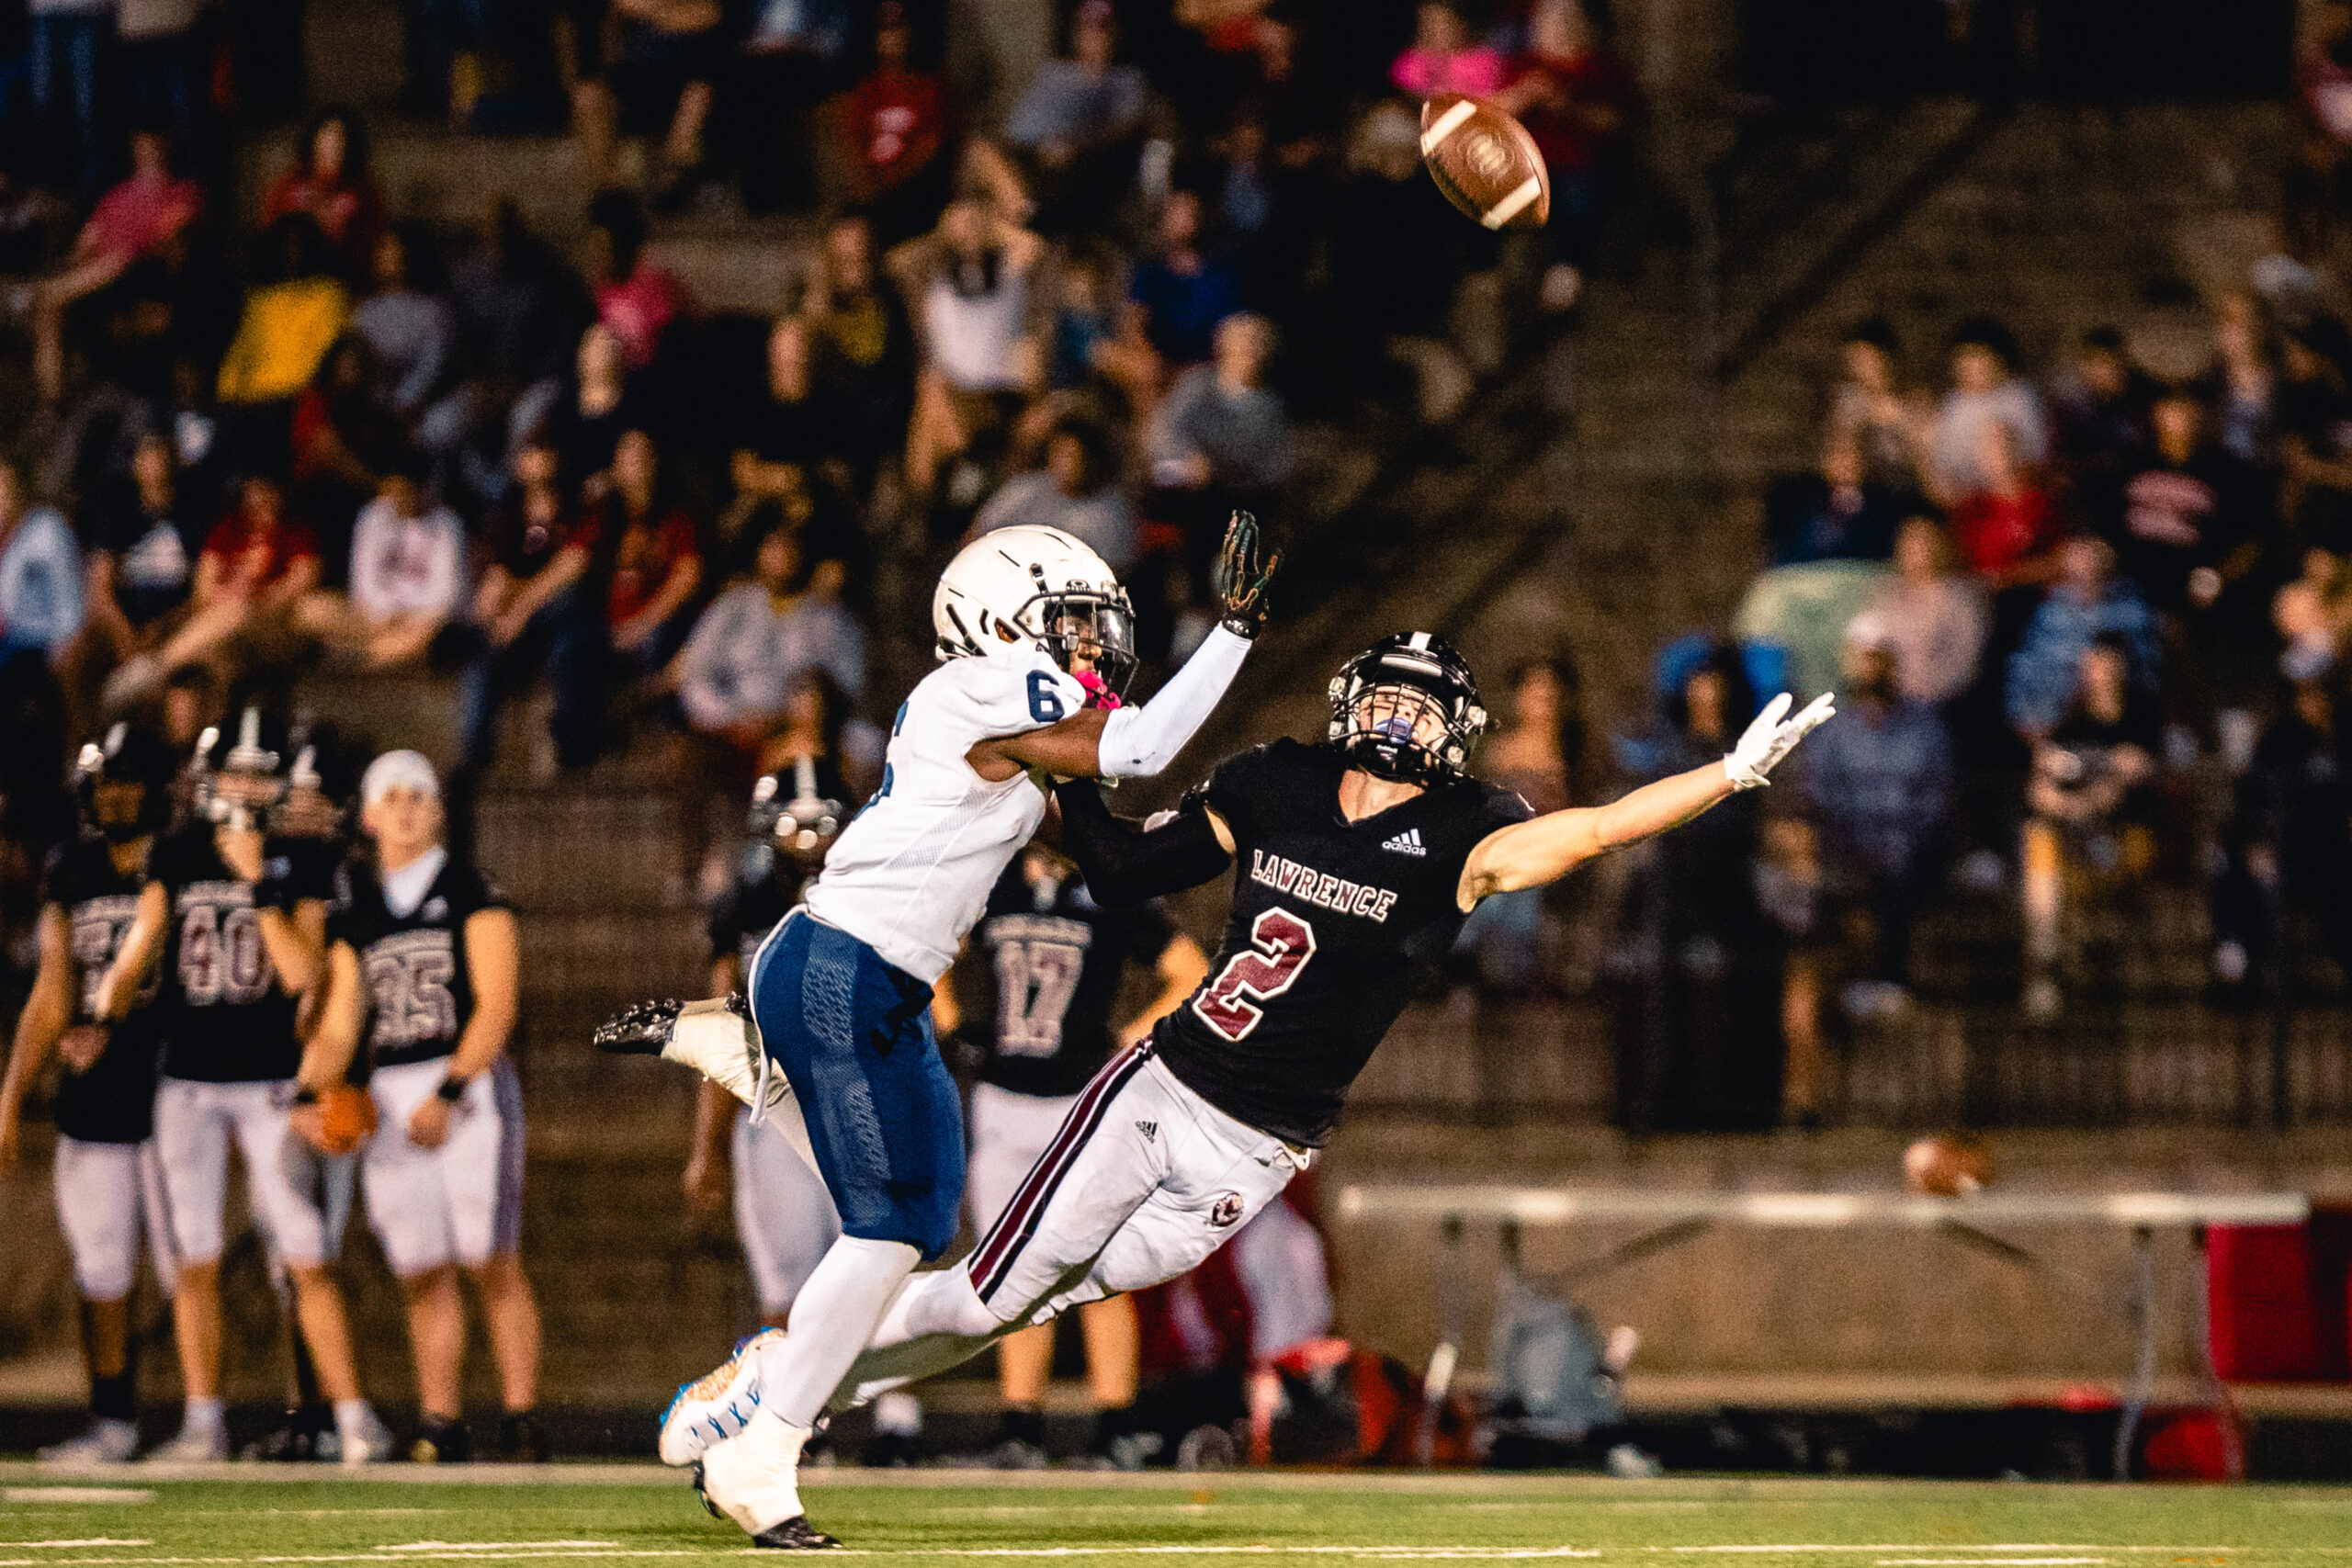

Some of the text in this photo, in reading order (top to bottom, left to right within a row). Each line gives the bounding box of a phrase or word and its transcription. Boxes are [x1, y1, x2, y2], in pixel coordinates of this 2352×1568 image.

[1025, 669, 1065, 723] 6
[1381, 839, 1427, 856] adidas
[1250, 849, 1398, 923] LAWRENCE
[995, 939, 1083, 1056] 17
[1192, 906, 1317, 1042] 2
